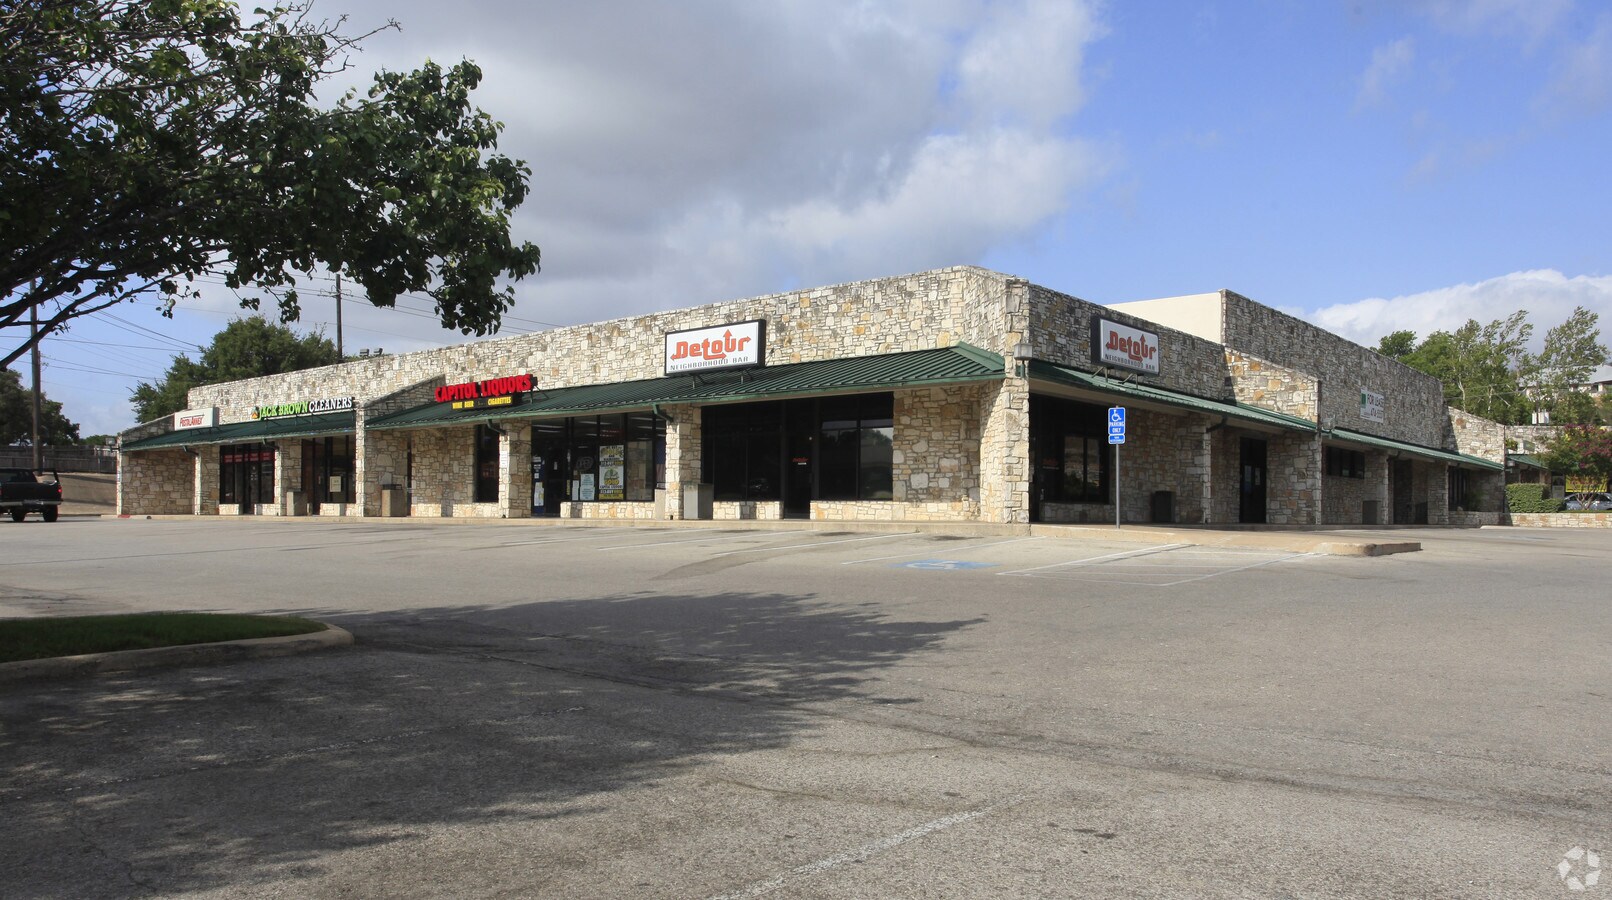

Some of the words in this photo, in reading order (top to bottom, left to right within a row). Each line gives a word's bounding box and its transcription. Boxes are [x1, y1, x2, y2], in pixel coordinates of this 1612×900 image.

[670, 329, 751, 361] Detour
[1106, 331, 1156, 363] Detour
[670, 357, 729, 371] NEIGHBORHOOD
[732, 355, 749, 364] BAR
[434, 382, 479, 403] CAPITOL
[481, 374, 532, 397] LIQUORS
[259, 405, 278, 421] JACK
[279, 401, 308, 417] BROWN
[308, 397, 353, 413] CLEANERS
